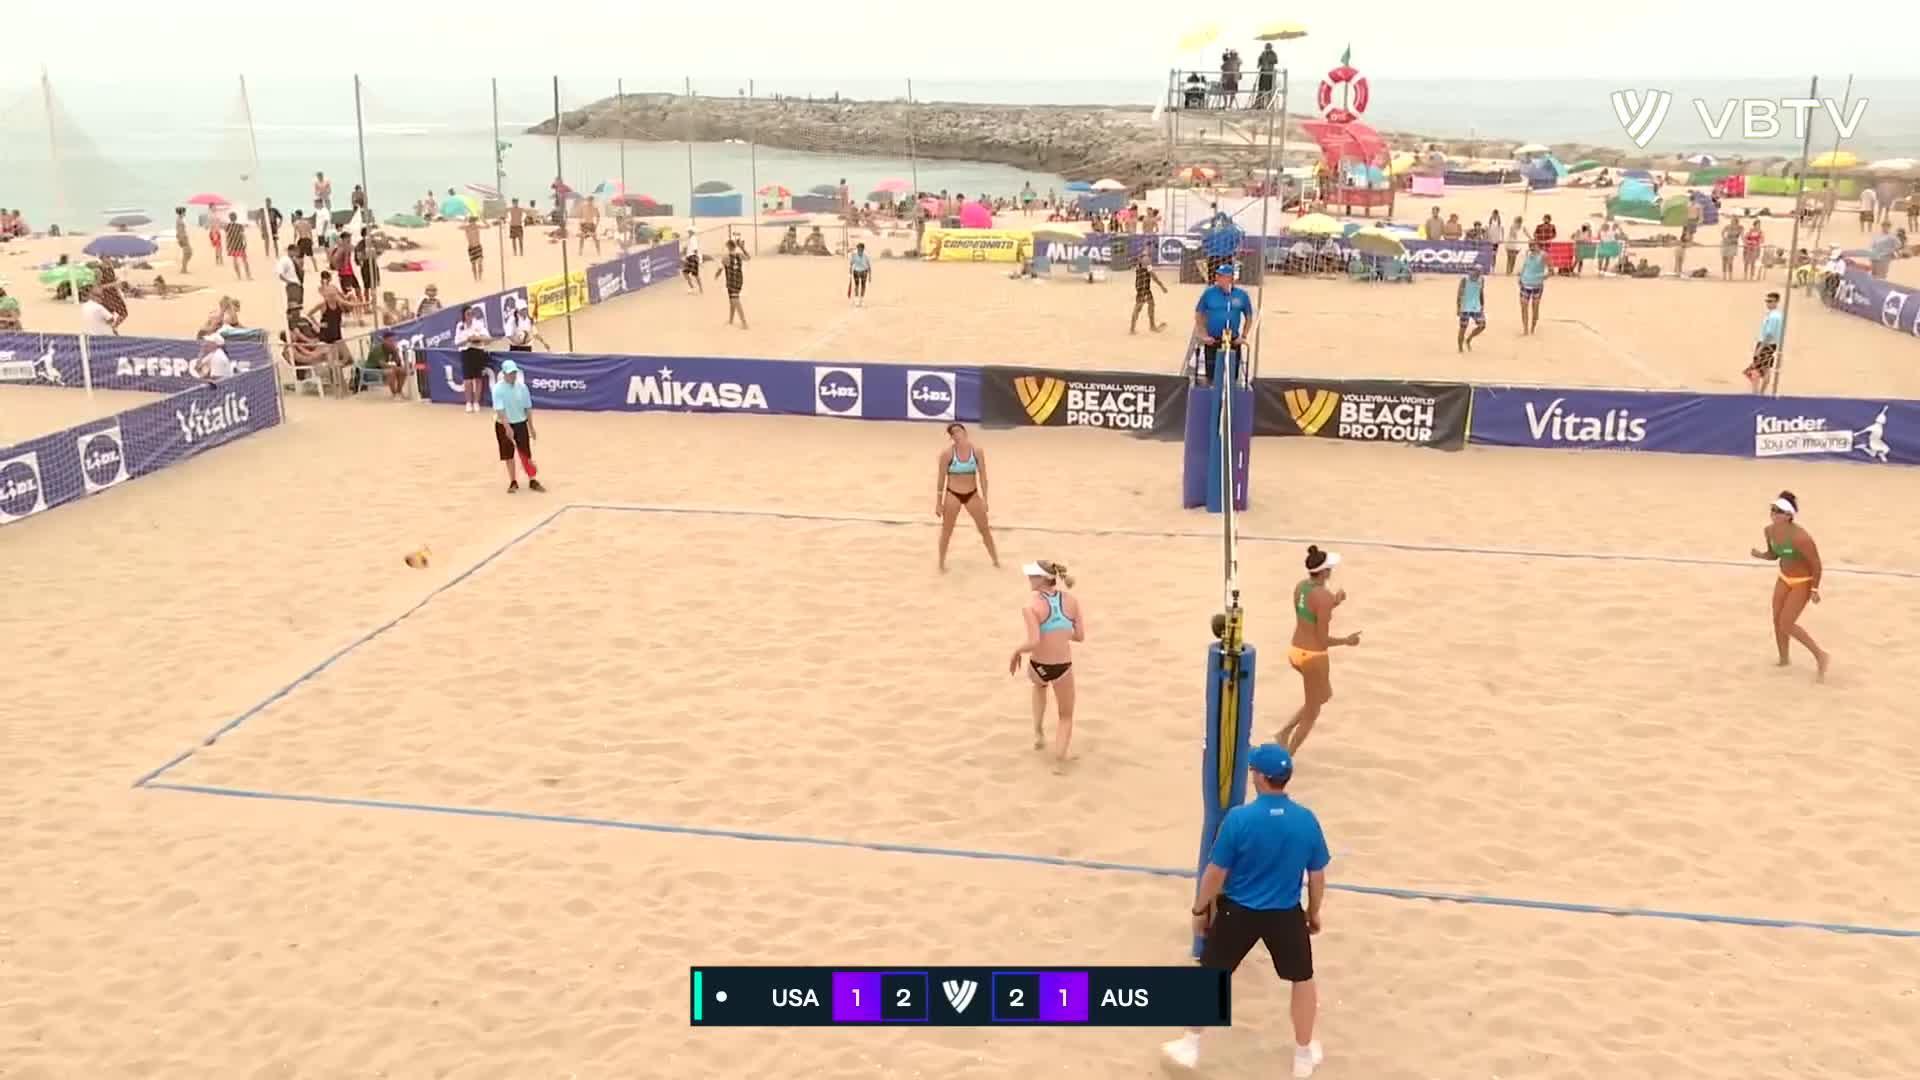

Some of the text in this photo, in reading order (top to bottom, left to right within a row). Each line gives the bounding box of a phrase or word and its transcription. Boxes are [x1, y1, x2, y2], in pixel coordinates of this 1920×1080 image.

[1047, 242, 1112, 261] MIKAS
[531, 377, 587, 392] seguros
[626, 366, 769, 409] MIKASA
[1068, 382, 1156, 393] VOLLEYBALL WORLD
[1067, 390, 1156, 413] BEACH
[1342, 394, 1435, 405] VOLLEYBALL WORLD
[176, 392, 249, 443] Vitalis
[1066, 410, 1154, 429] PRO TOUR
[1340, 402, 1434, 427] BEACH
[1525, 398, 1647, 442] Vitalis
[1756, 414, 1827, 434] Kinder
[1338, 423, 1432, 441] PRO TOUR
[1760, 436, 1847, 450] Joy of moving
